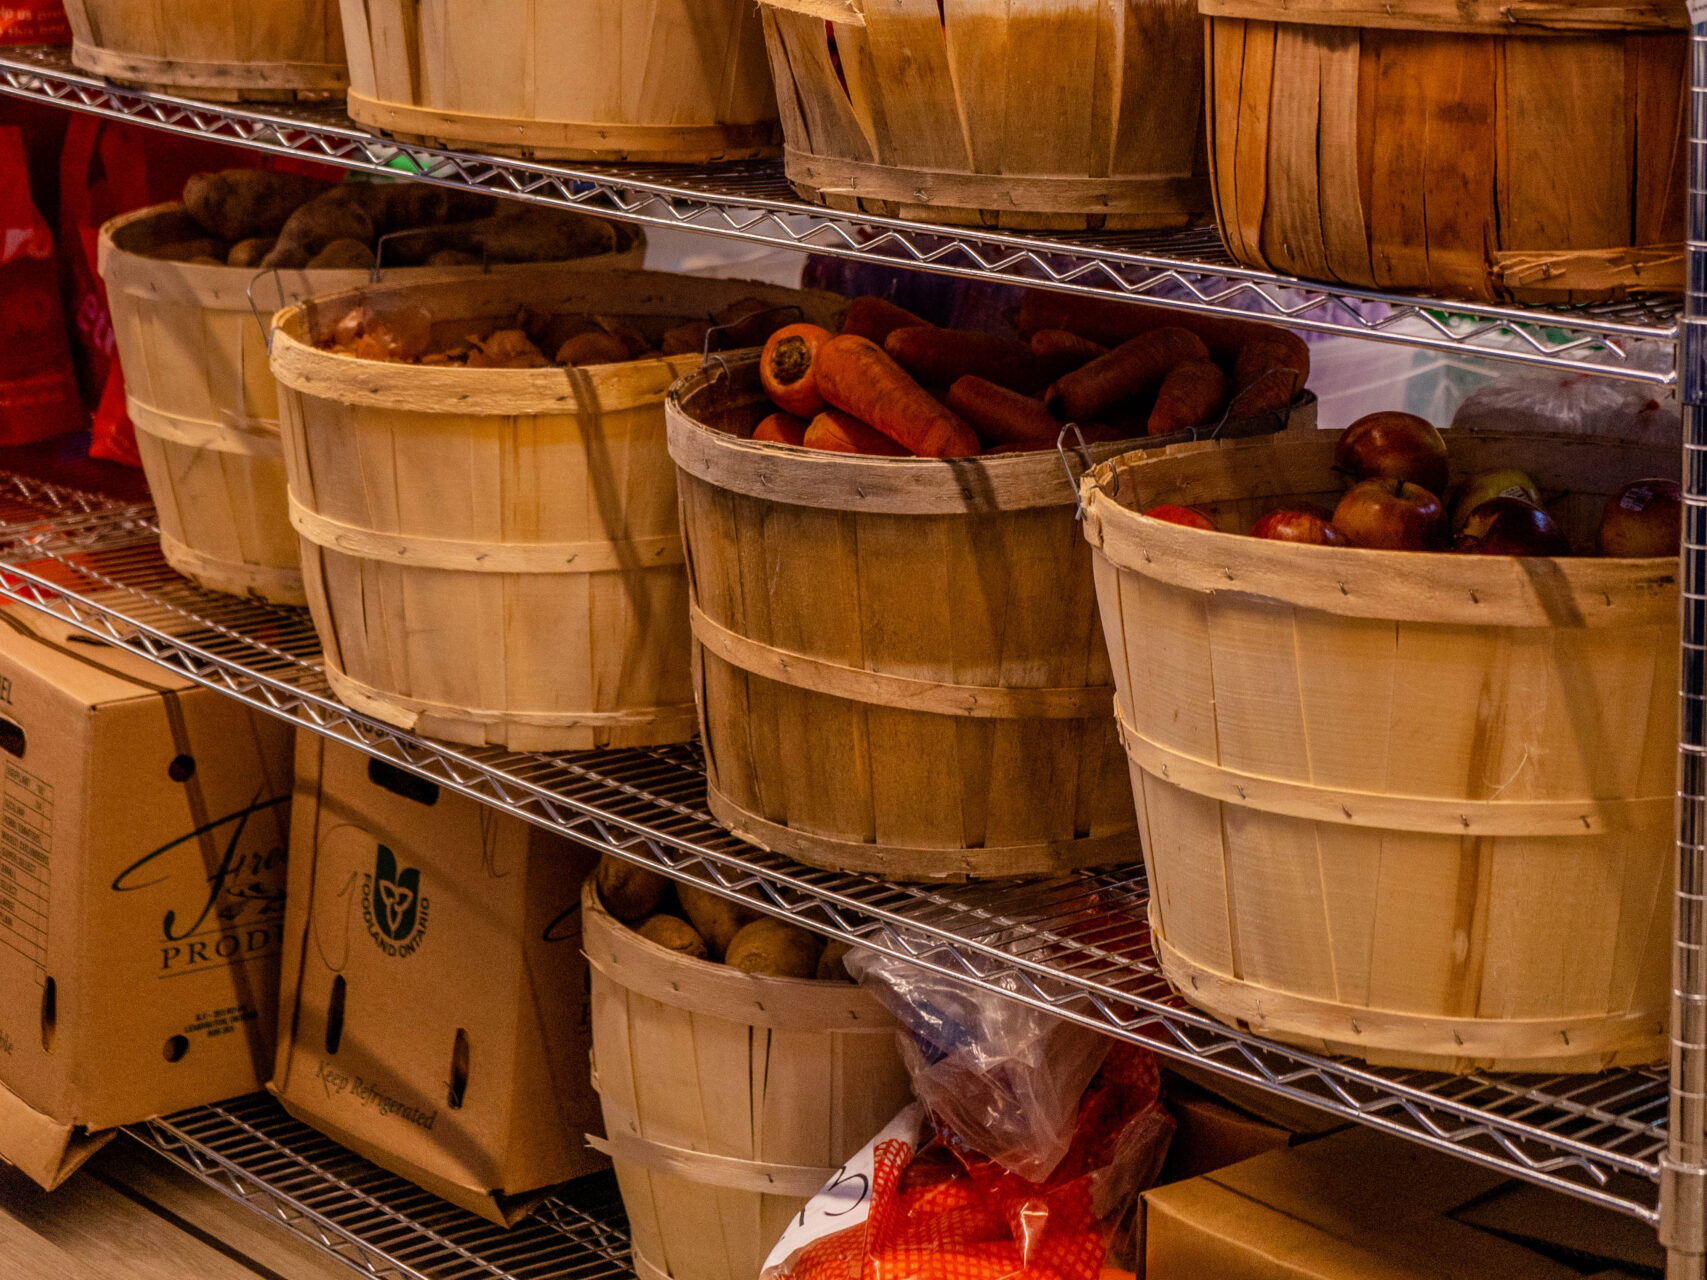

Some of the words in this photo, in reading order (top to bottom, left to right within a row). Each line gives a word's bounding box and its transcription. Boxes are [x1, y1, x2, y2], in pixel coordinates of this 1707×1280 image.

[361, 873, 397, 958] FOODLAND
[399, 896, 430, 958] ONTARIO
[316, 1061, 349, 1099] Keep
[348, 1075, 438, 1131] Refrigerated
